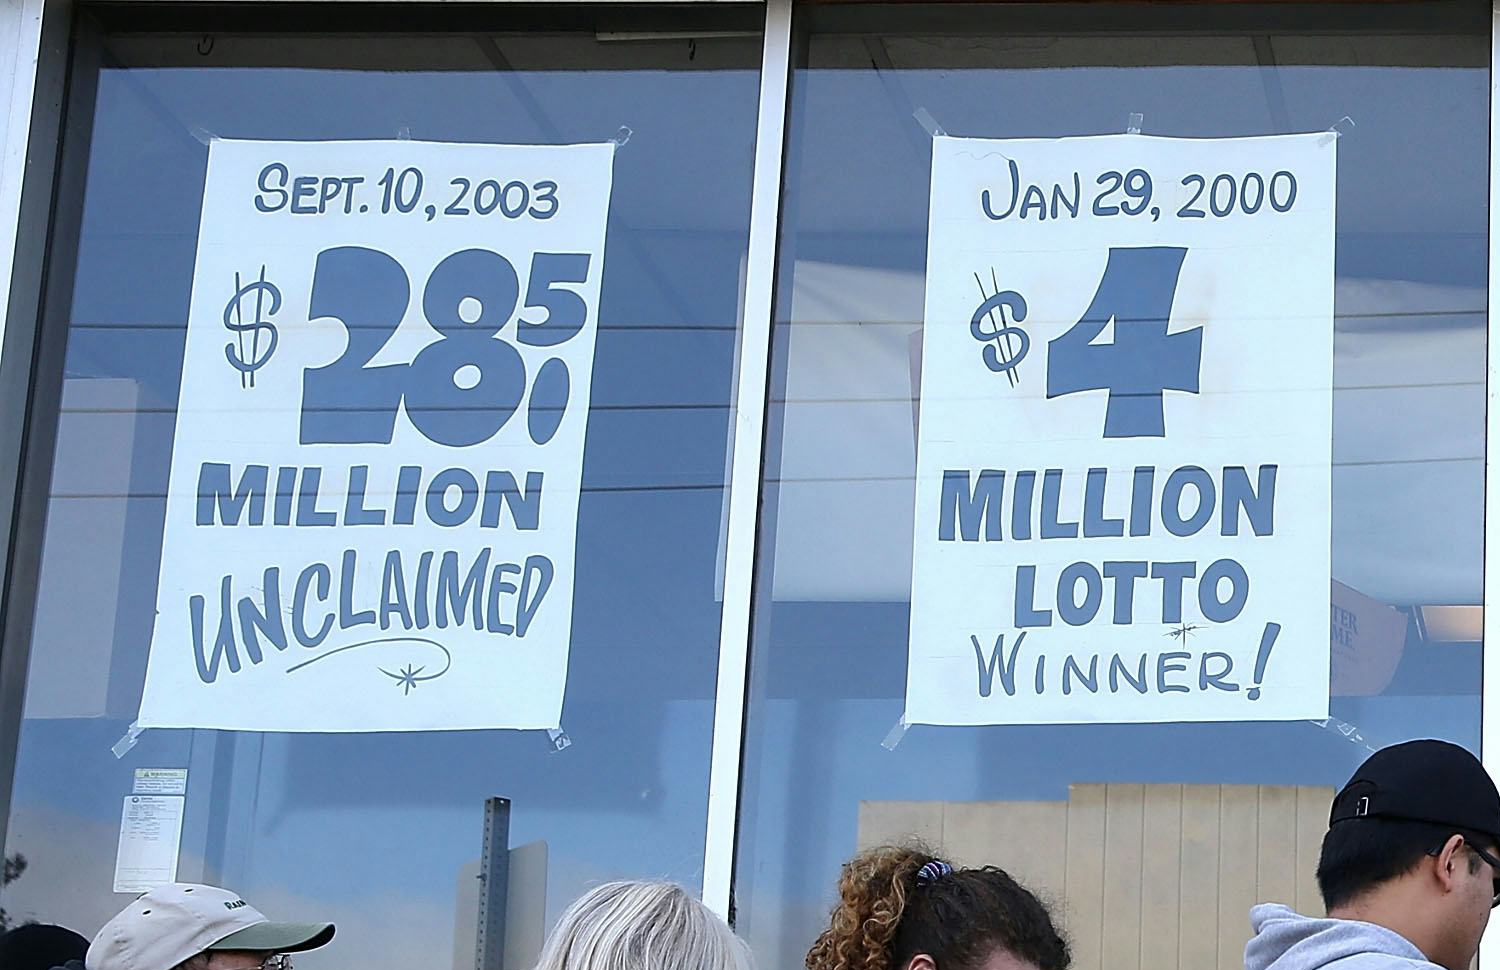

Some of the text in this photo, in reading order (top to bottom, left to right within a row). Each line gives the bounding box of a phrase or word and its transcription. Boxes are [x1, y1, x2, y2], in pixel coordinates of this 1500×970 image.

[255, 163, 368, 214] SEPT.
[449, 178, 558, 219] 2003
[982, 159, 1297, 222] JAN 29, 2000
[196, 462, 544, 530] MILLION
[938, 464, 1278, 542] MILLION
[189, 547, 554, 683] UNCLAIMED
[1014, 559, 1249, 628] LOTTO
[970, 622, 1281, 701] WINNER!
